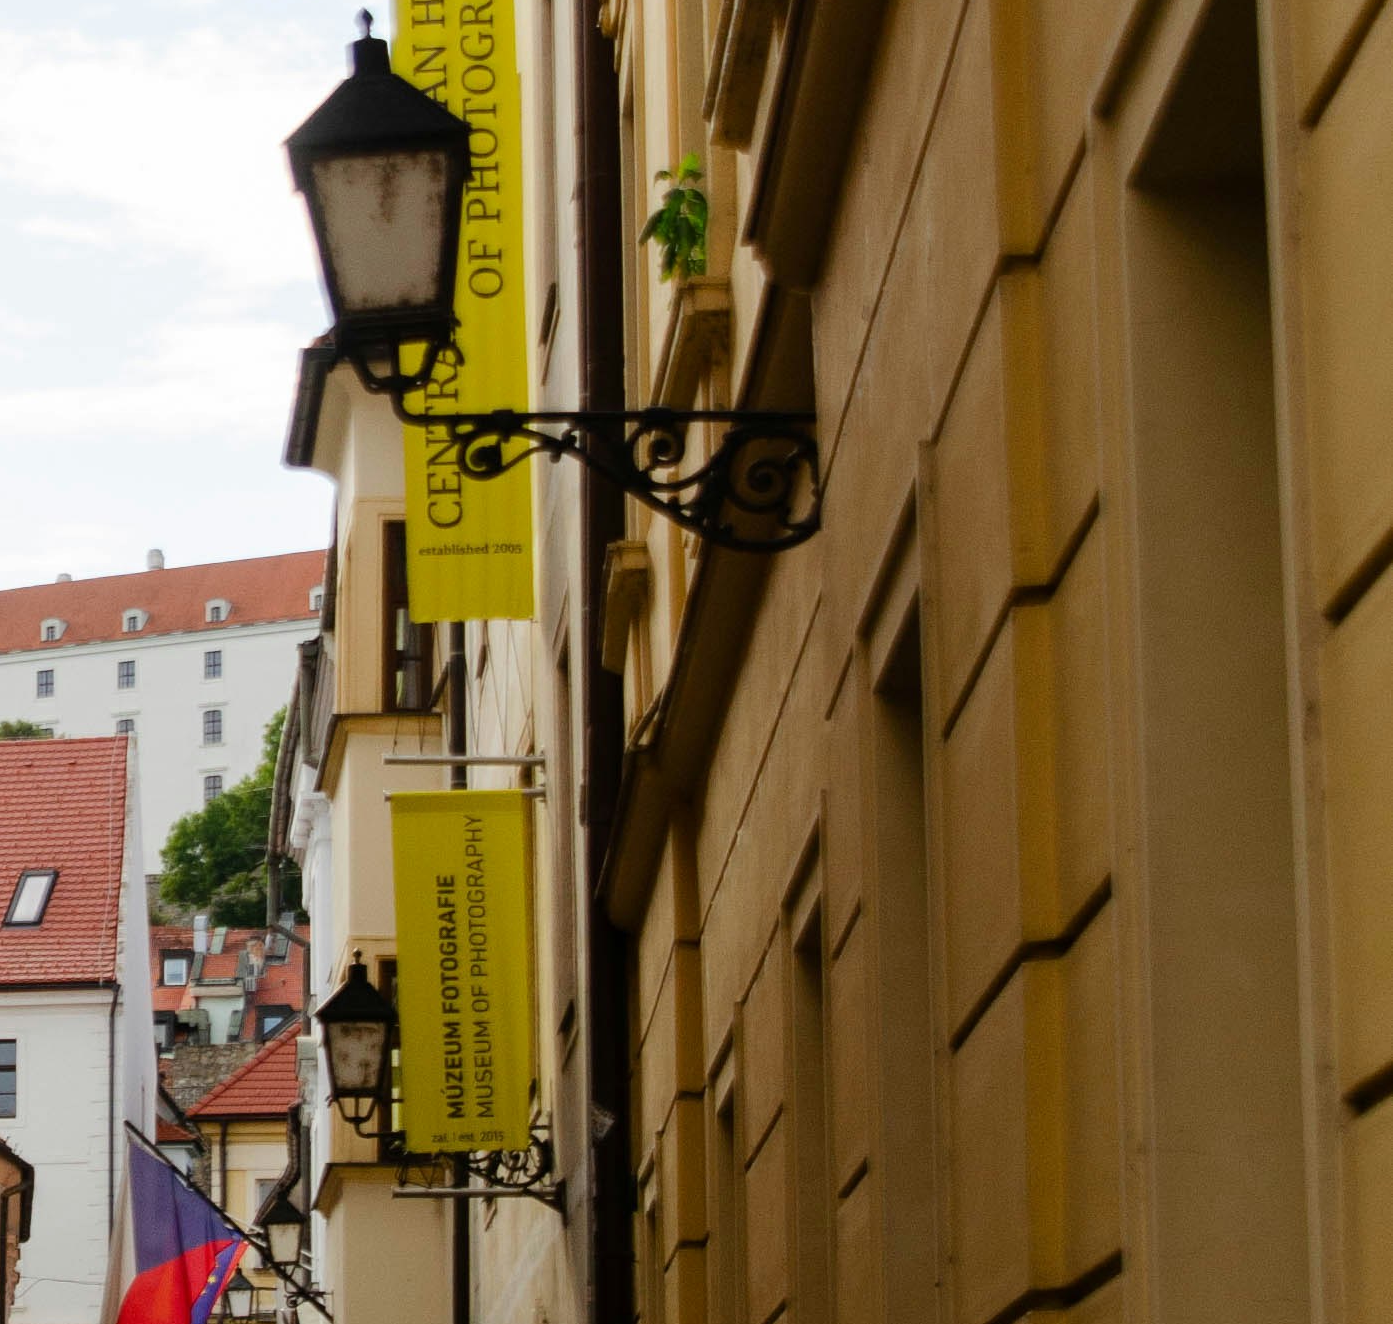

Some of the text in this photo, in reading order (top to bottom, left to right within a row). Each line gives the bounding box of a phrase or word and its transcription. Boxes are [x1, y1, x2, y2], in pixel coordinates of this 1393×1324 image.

[468, 239, 503, 298] OF
[418, 542, 523, 556] established 2005
[437, 875, 465, 1119] MÚZEUM FOTOGRAFIE
[465, 815, 495, 1119] MUSEUM OF PHOTOGRAPHY
